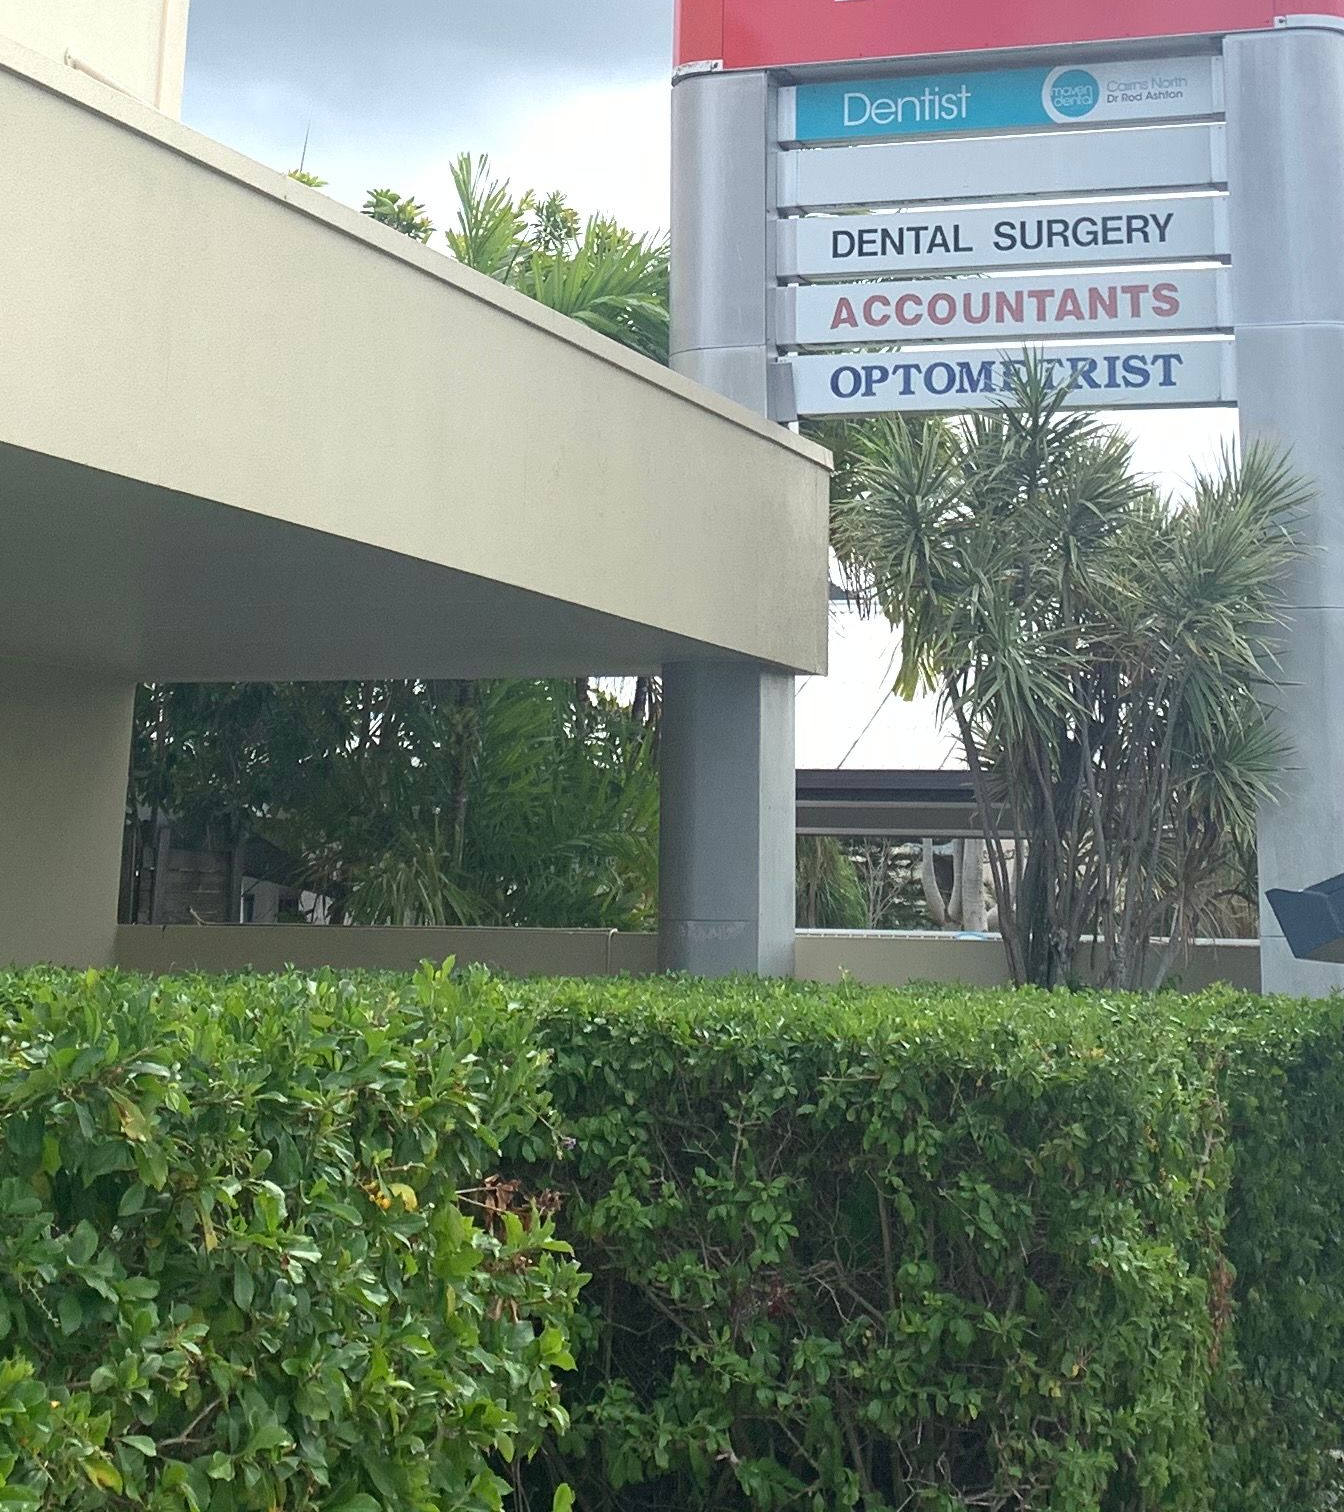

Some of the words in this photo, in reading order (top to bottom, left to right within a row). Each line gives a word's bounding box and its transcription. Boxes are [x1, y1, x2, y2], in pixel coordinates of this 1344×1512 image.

[1106, 94, 1118, 104] Dr
[1121, 92, 1143, 103] Rod
[1145, 89, 1183, 101] Ashton
[1151, 76, 1188, 89] North
[843, 84, 972, 127] Dentist
[1054, 93, 1093, 107] dental
[831, 225, 973, 259] DENTAL
[993, 213, 1174, 252] SURGERY
[830, 283, 1180, 330] ACCOUNTANTS
